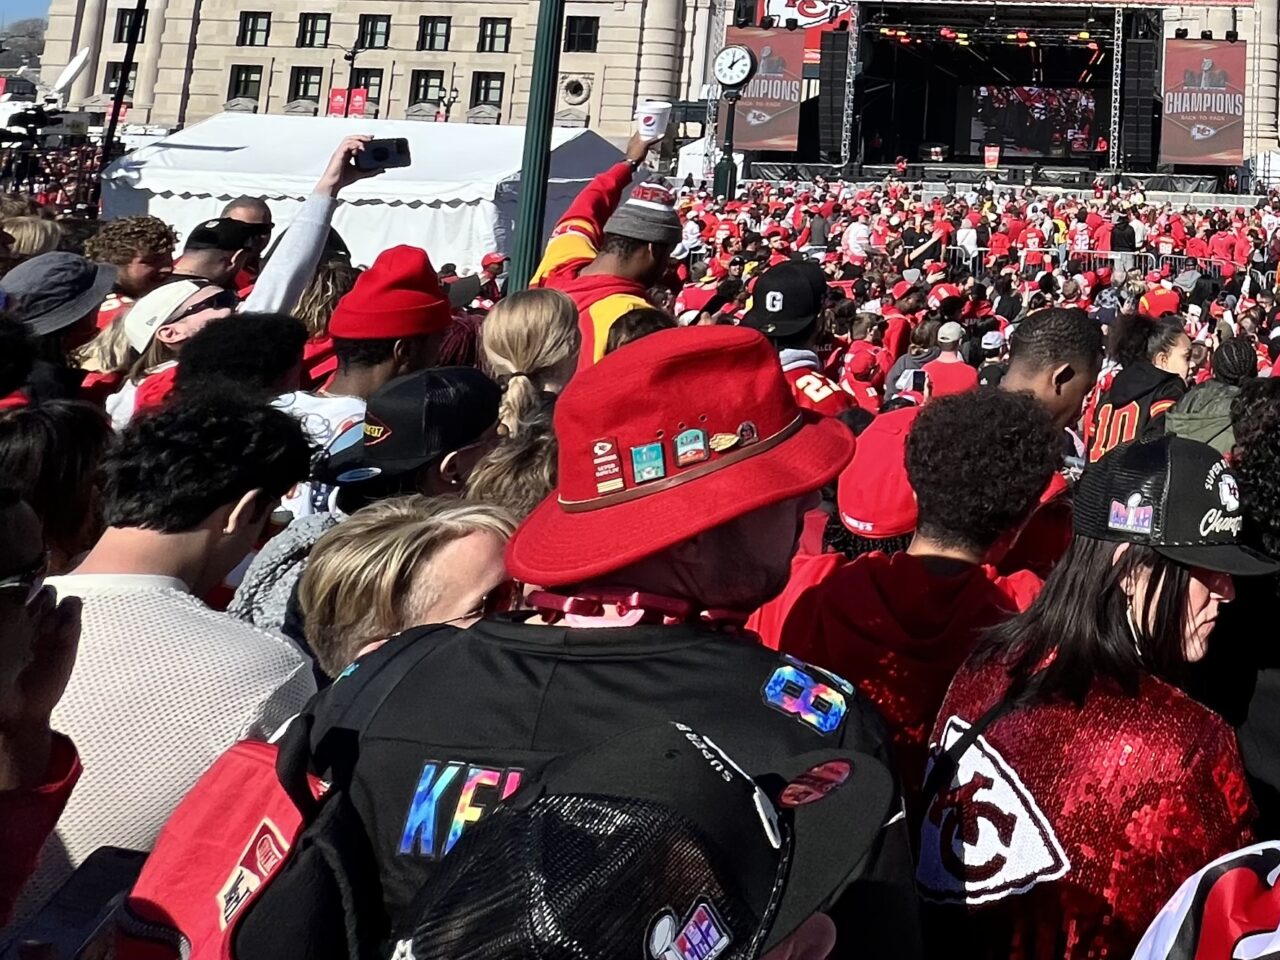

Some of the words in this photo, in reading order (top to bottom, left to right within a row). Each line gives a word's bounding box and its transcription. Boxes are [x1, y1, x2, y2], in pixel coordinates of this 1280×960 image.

[740, 79, 799, 101] AMPIONS
[1165, 92, 1243, 116] CHAMPIONS
[766, 291, 783, 312] G
[1089, 401, 1140, 463] 10
[1204, 461, 1223, 491] SUPER
[763, 656, 851, 734] 8
